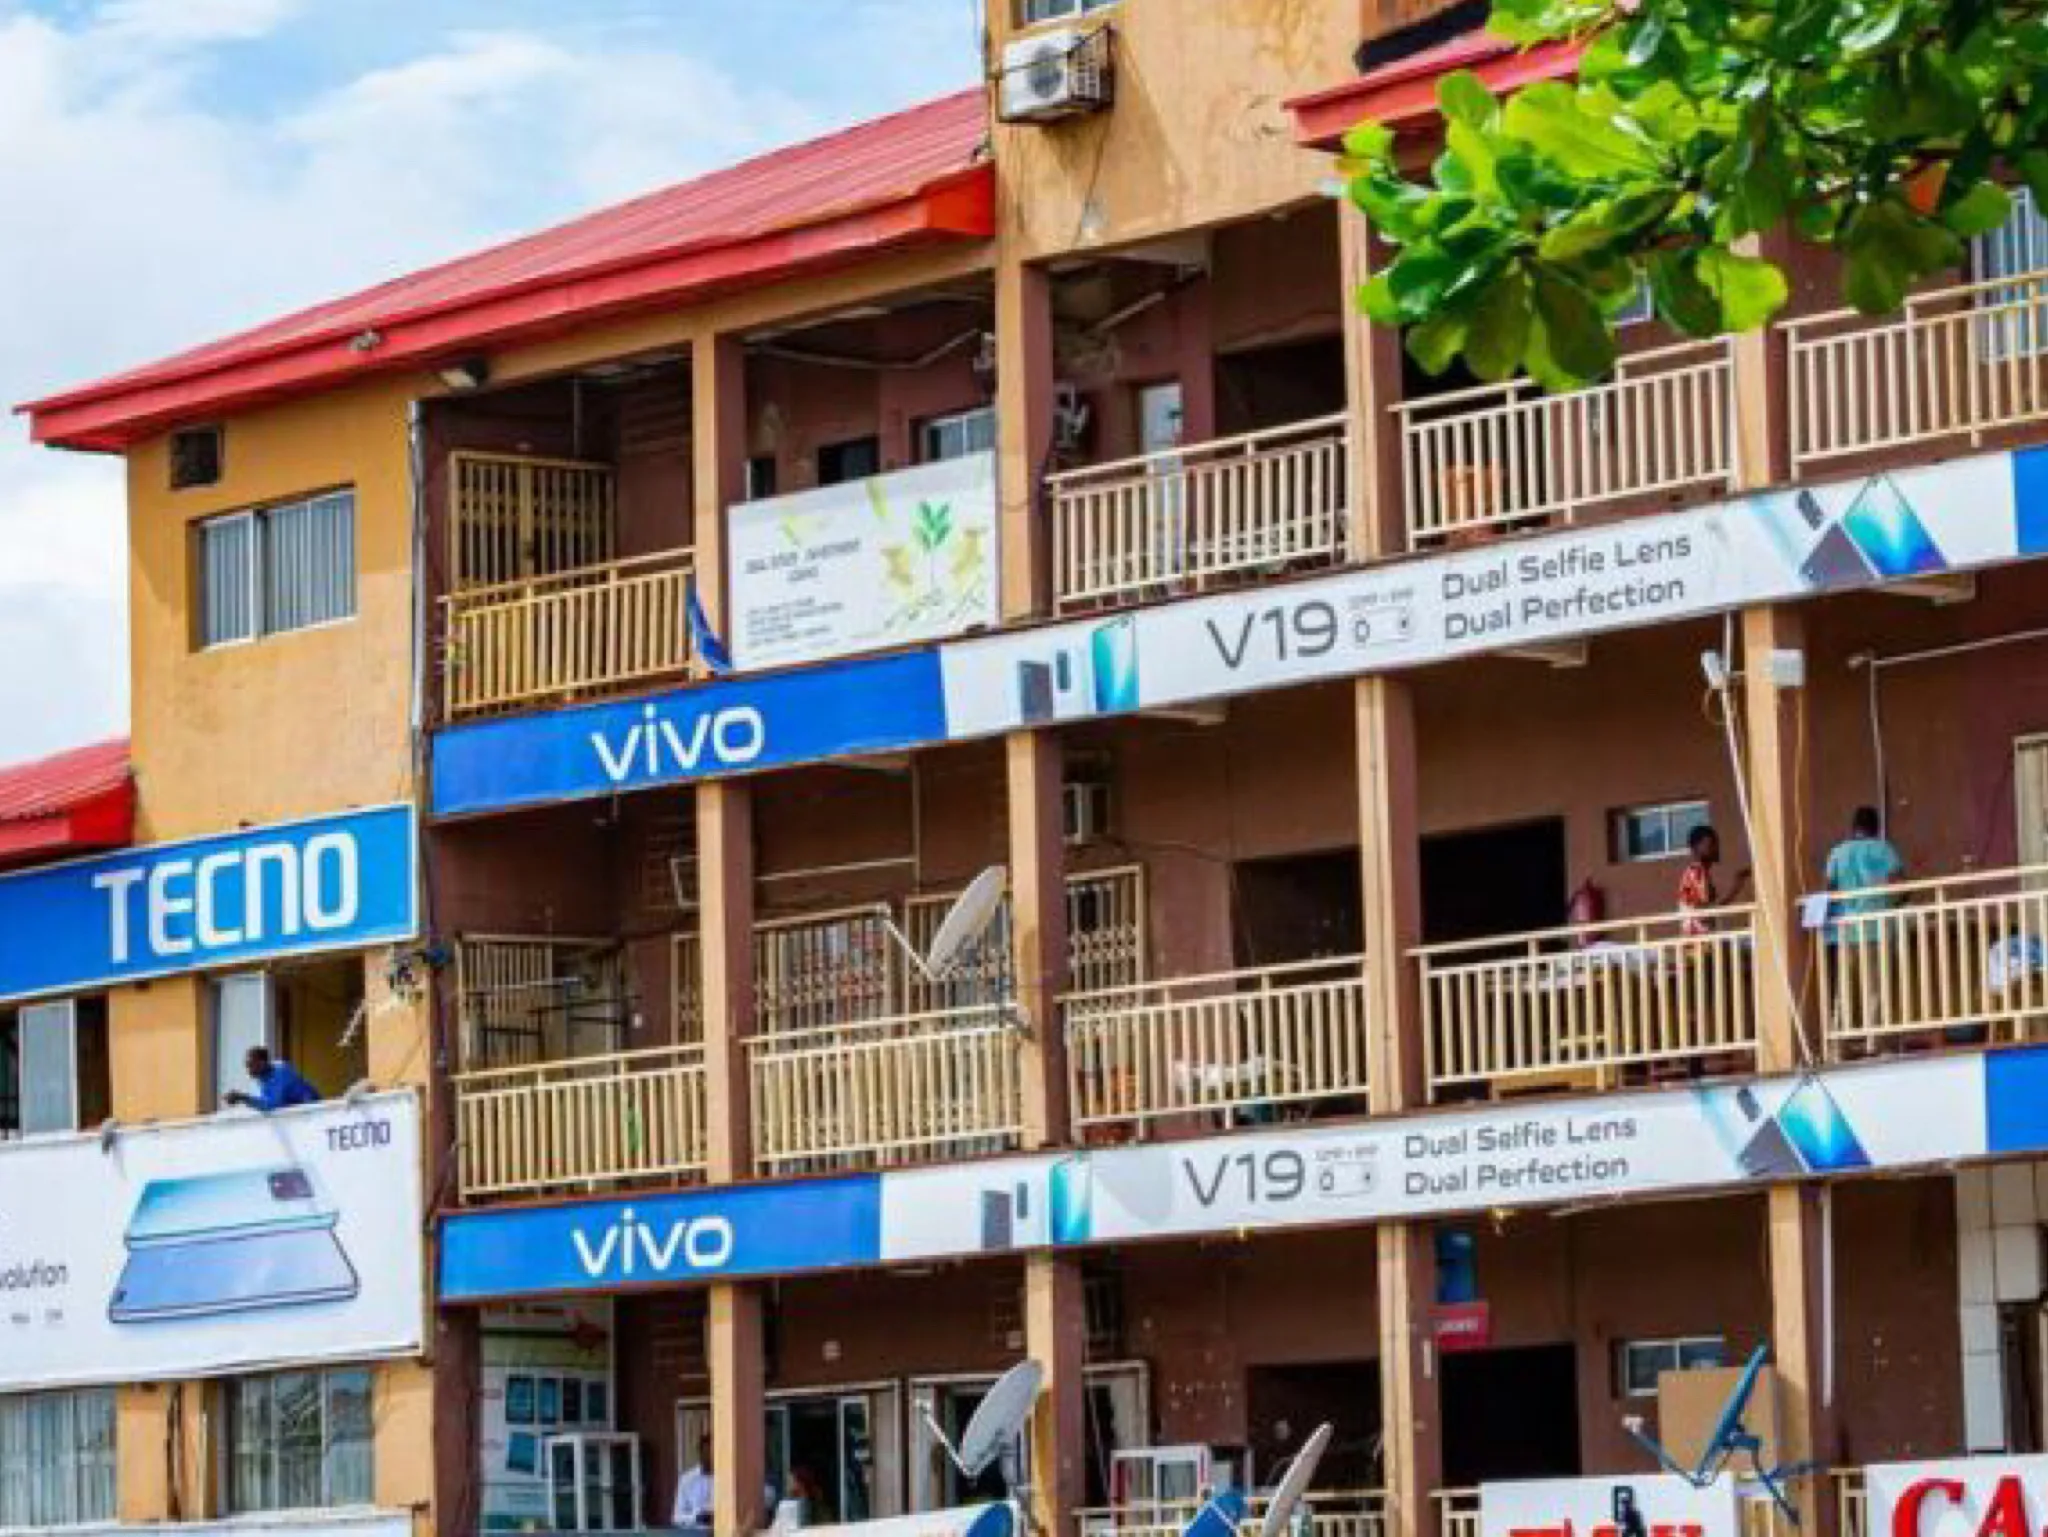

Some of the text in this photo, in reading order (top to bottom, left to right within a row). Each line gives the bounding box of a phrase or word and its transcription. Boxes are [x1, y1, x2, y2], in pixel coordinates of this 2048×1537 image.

[1442, 558, 1508, 600] Dual
[1518, 544, 1605, 583] Selfie
[1615, 534, 1692, 568] Lens
[1206, 599, 1338, 670] V19
[1445, 577, 1685, 640] Dual Perfection
[590, 703, 765, 780] vivo
[92, 831, 359, 963] TECNO
[325, 1121, 391, 1151] TECNO
[1405, 1129, 1468, 1159] Dual
[1477, 1120, 1558, 1152] Selfie
[1566, 1116, 1638, 1144] Lens
[1183, 1149, 1307, 1208] V19
[1405, 1153, 1630, 1195] Dual Perfection
[570, 1207, 735, 1278] vivo
